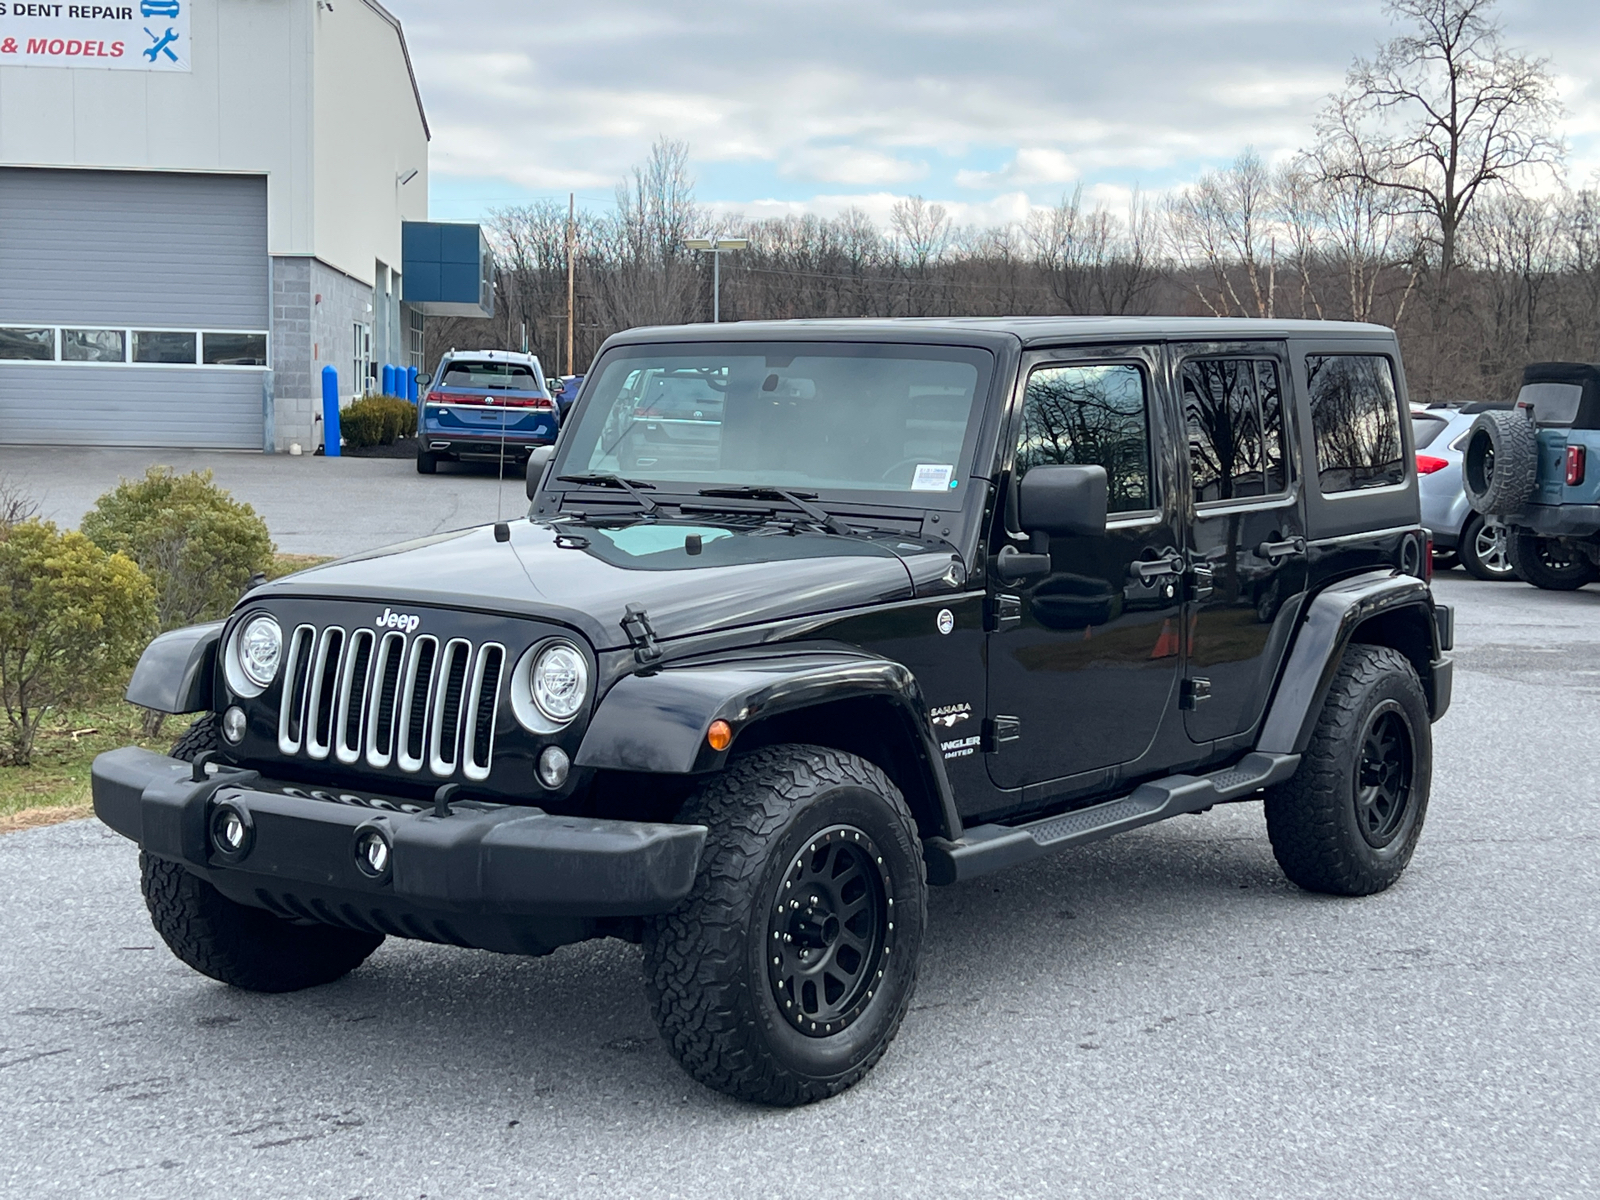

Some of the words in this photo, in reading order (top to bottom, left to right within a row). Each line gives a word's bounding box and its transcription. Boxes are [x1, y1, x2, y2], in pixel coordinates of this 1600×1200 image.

[13, 3, 63, 17] DENT
[68, 5, 133, 20] REPAIR
[1, 37, 19, 54] &
[26, 38, 125, 58] MODELS
[375, 607, 420, 634] Jeep
[931, 702, 972, 716] SAHARA
[944, 748, 974, 759] IMITED
